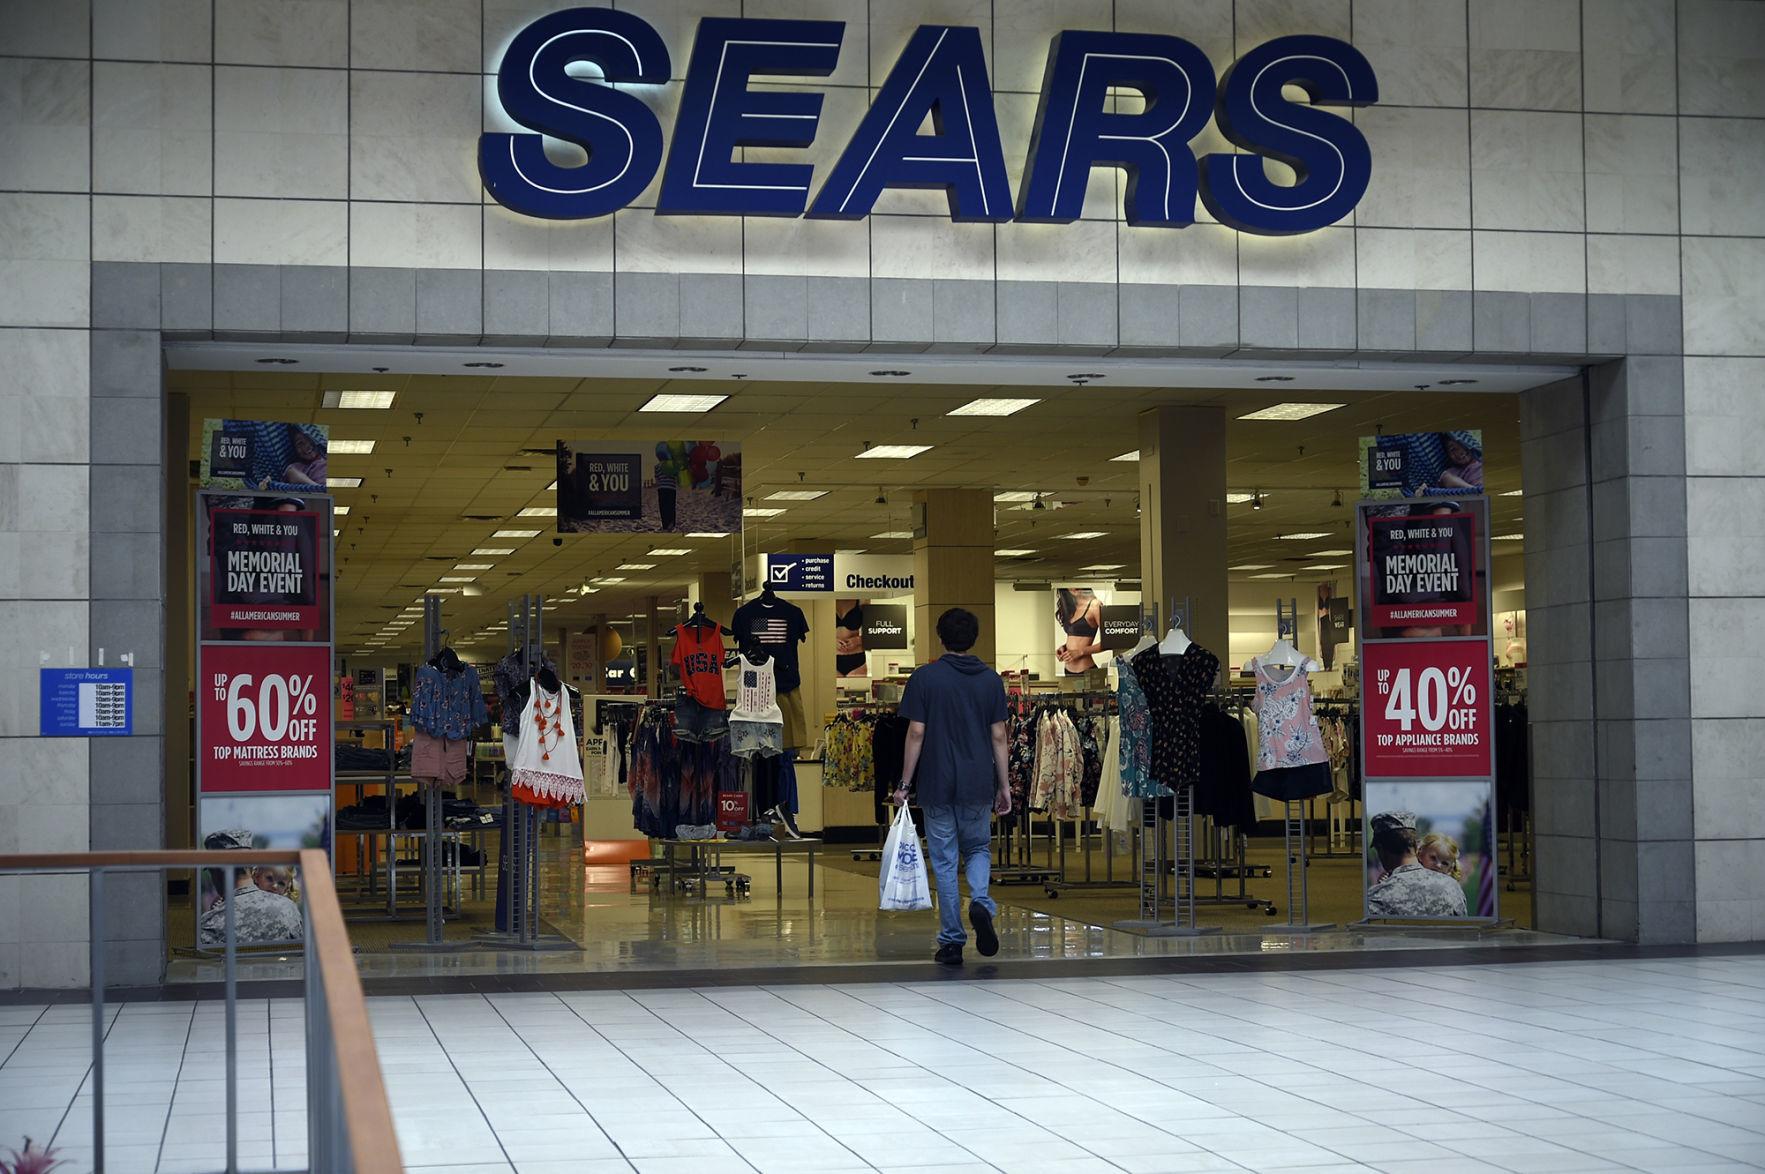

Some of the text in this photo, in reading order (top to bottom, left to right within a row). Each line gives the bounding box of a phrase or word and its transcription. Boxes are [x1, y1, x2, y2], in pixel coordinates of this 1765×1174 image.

[478, 6, 1379, 235] SEARS
[219, 445, 246, 459] & YOU
[589, 463, 629, 474] RED, WHITE
[1375, 458, 1401, 471] & YOU
[588, 474, 629, 492] & YOU
[233, 523, 298, 536] RED, WHITE & YOU
[1390, 527, 1453, 541] RED, WHITE & YOU
[227, 550, 303, 573] MEMORIAL
[1385, 552, 1459, 575] MEMORIAL
[227, 573, 303, 594] DAY EVENT
[846, 573, 914, 589] Checkout
[1386, 573, 1459, 594] DAY EVENT
[230, 611, 300, 622] #ALLAMERICANSUMMER
[1390, 608, 1458, 619] #ALLAMERICANSUMMER
[868, 627, 902, 635] SUPPORT
[1105, 627, 1139, 635] COMFORT
[683, 652, 720, 676] USA
[84, 672, 108, 680] hours
[214, 673, 228, 687] UP
[1377, 669, 1390, 682] UP
[214, 687, 227, 701] TO
[1378, 682, 1389, 695] TO
[1385, 666, 1476, 732] 40%
[227, 673, 317, 742] 60%
[1449, 708, 1477, 730] OFF
[288, 719, 317, 742] OFF
[1377, 733, 1479, 746] TOP APPLIANCE BRANDS
[213, 745, 318, 760] TOP MATTRESS BRANDS
